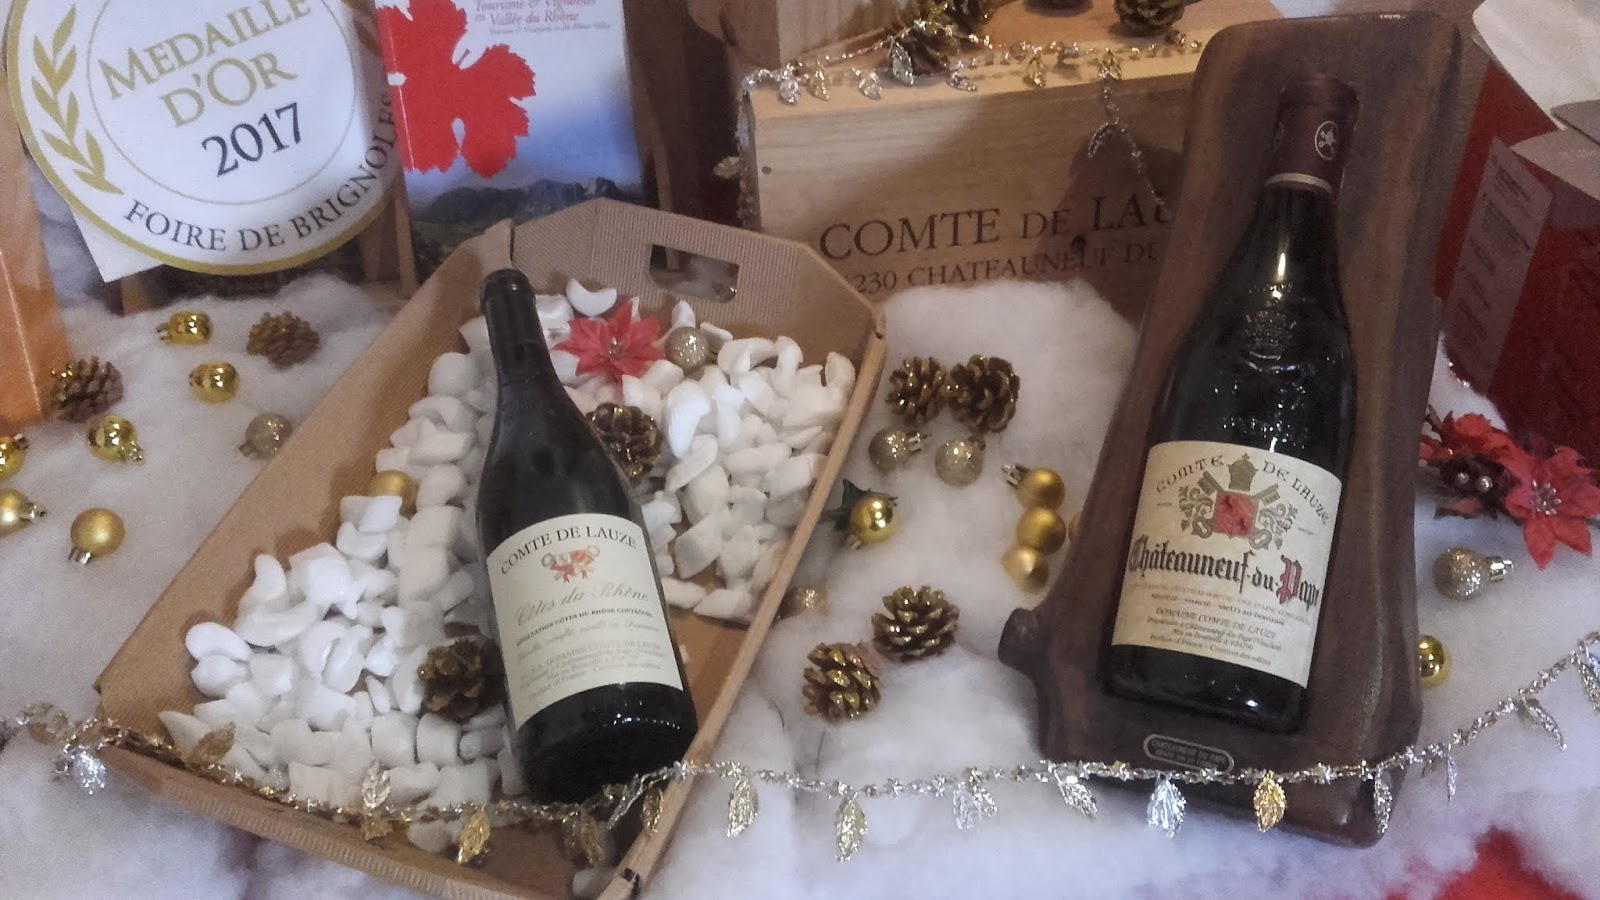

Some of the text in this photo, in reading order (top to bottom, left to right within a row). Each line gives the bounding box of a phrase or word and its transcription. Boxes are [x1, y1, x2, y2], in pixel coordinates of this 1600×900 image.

[98, 0, 312, 101] MEDAILLE
[158, 51, 299, 128] D'OR
[123, 94, 398, 253] FOIRE DE BRIGNOLES
[201, 102, 302, 178] 2017
[818, 206, 1000, 261] COMTE
[1021, 208, 1073, 239] DE
[853, 270, 898, 294] 230
[1155, 453, 1331, 526] COMTE DE LAUZE
[500, 525, 638, 576] COMTE DE LAUZE
[560, 586, 586, 606] du
[591, 579, 650, 602] Rhône
